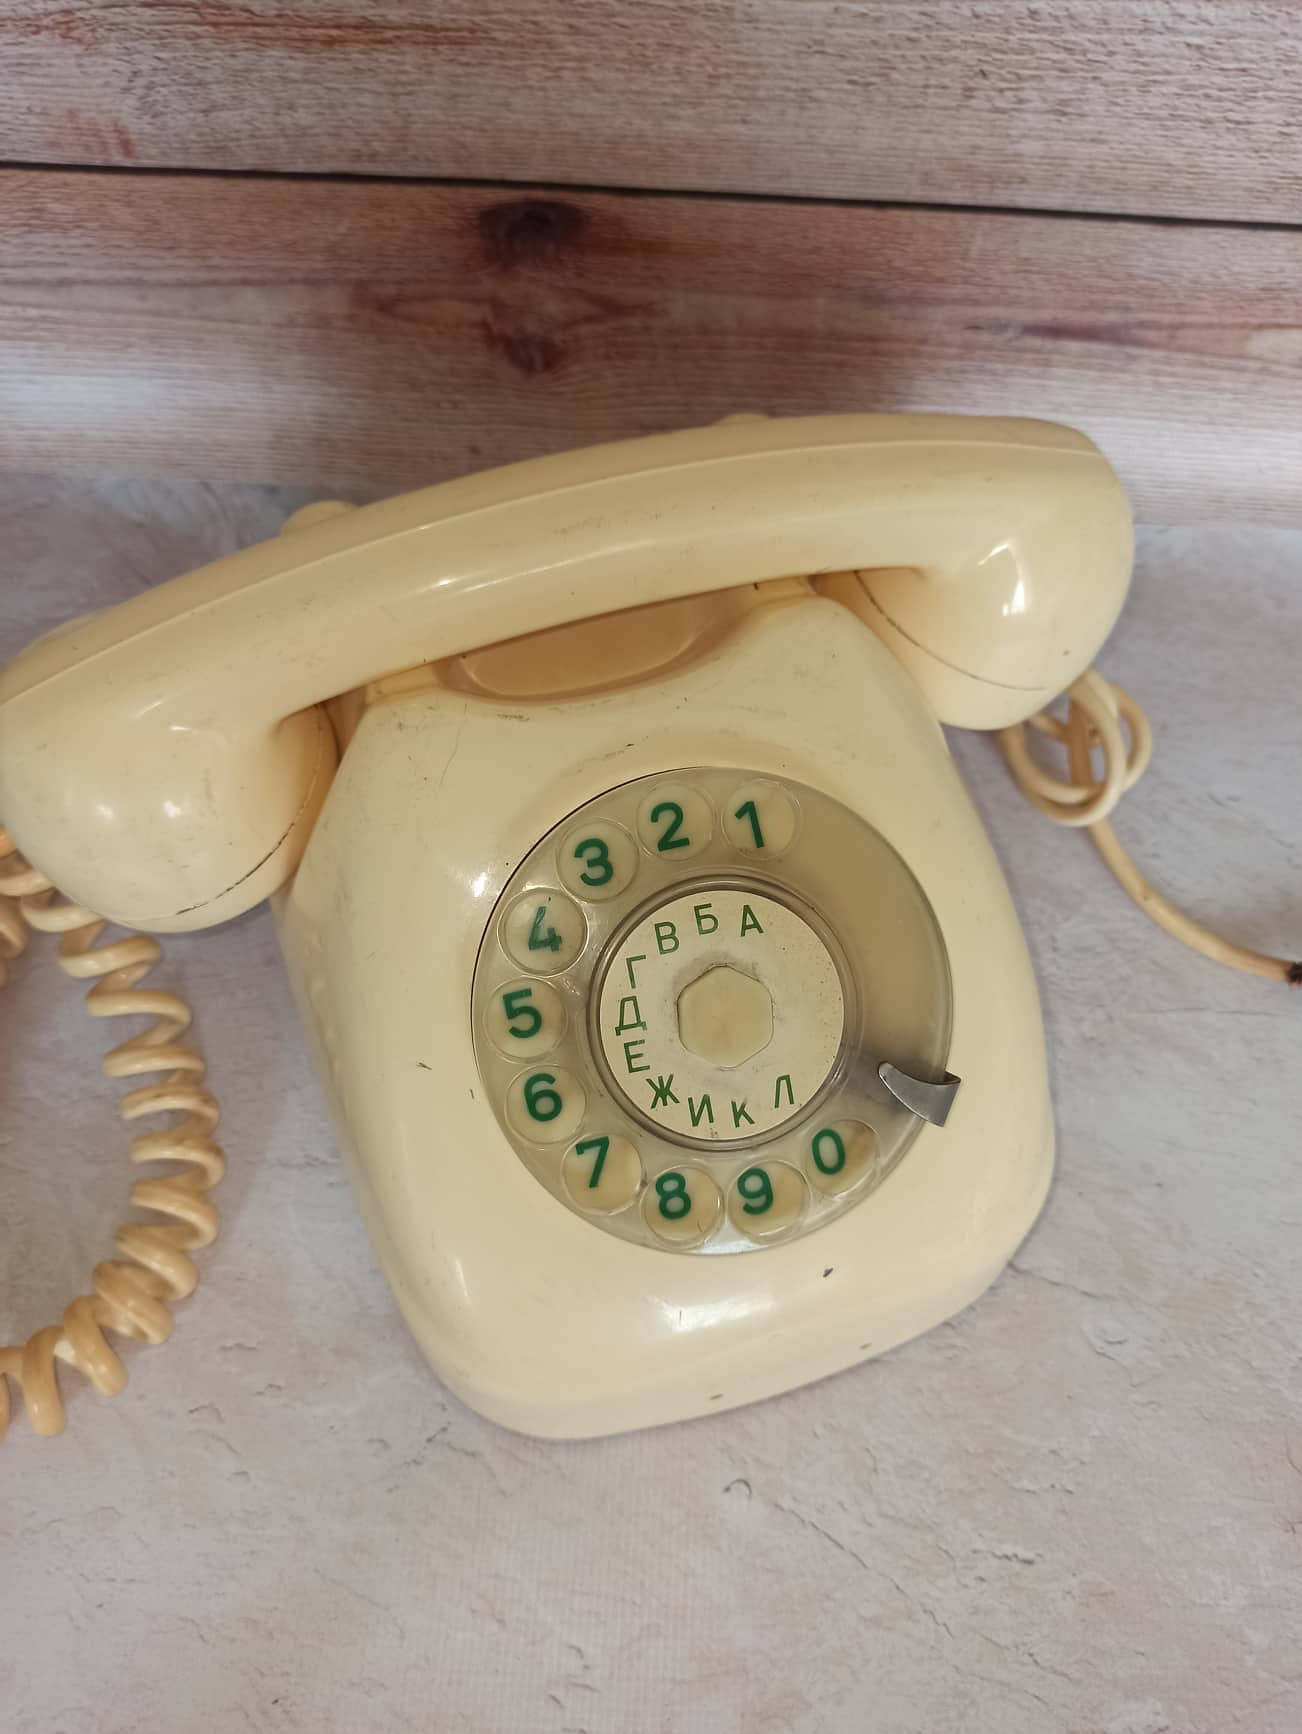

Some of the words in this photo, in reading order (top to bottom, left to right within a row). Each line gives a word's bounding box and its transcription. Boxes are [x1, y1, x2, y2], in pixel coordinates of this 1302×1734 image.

[649, 801, 690, 852] 2
[734, 800, 765, 849] 1
[572, 837, 614, 887] 3
[527, 905, 563, 953] 4
[653, 921, 681, 955] В
[693, 903, 720, 936] Б
[739, 904, 766, 938] А
[625, 954, 647, 990] Г
[501, 986, 543, 1040] 5
[614, 995, 648, 1037] Д
[623, 1039, 651, 1074] Е
[522, 1072, 563, 1123] 6
[645, 1073, 681, 1110] Ж
[687, 1093, 715, 1128] И
[730, 1099, 756, 1129] К
[773, 1074, 795, 1110] Л
[575, 1135, 611, 1189] 7
[810, 1127, 846, 1177] 0
[655, 1171, 692, 1222] 8
[736, 1167, 774, 1216] 9
